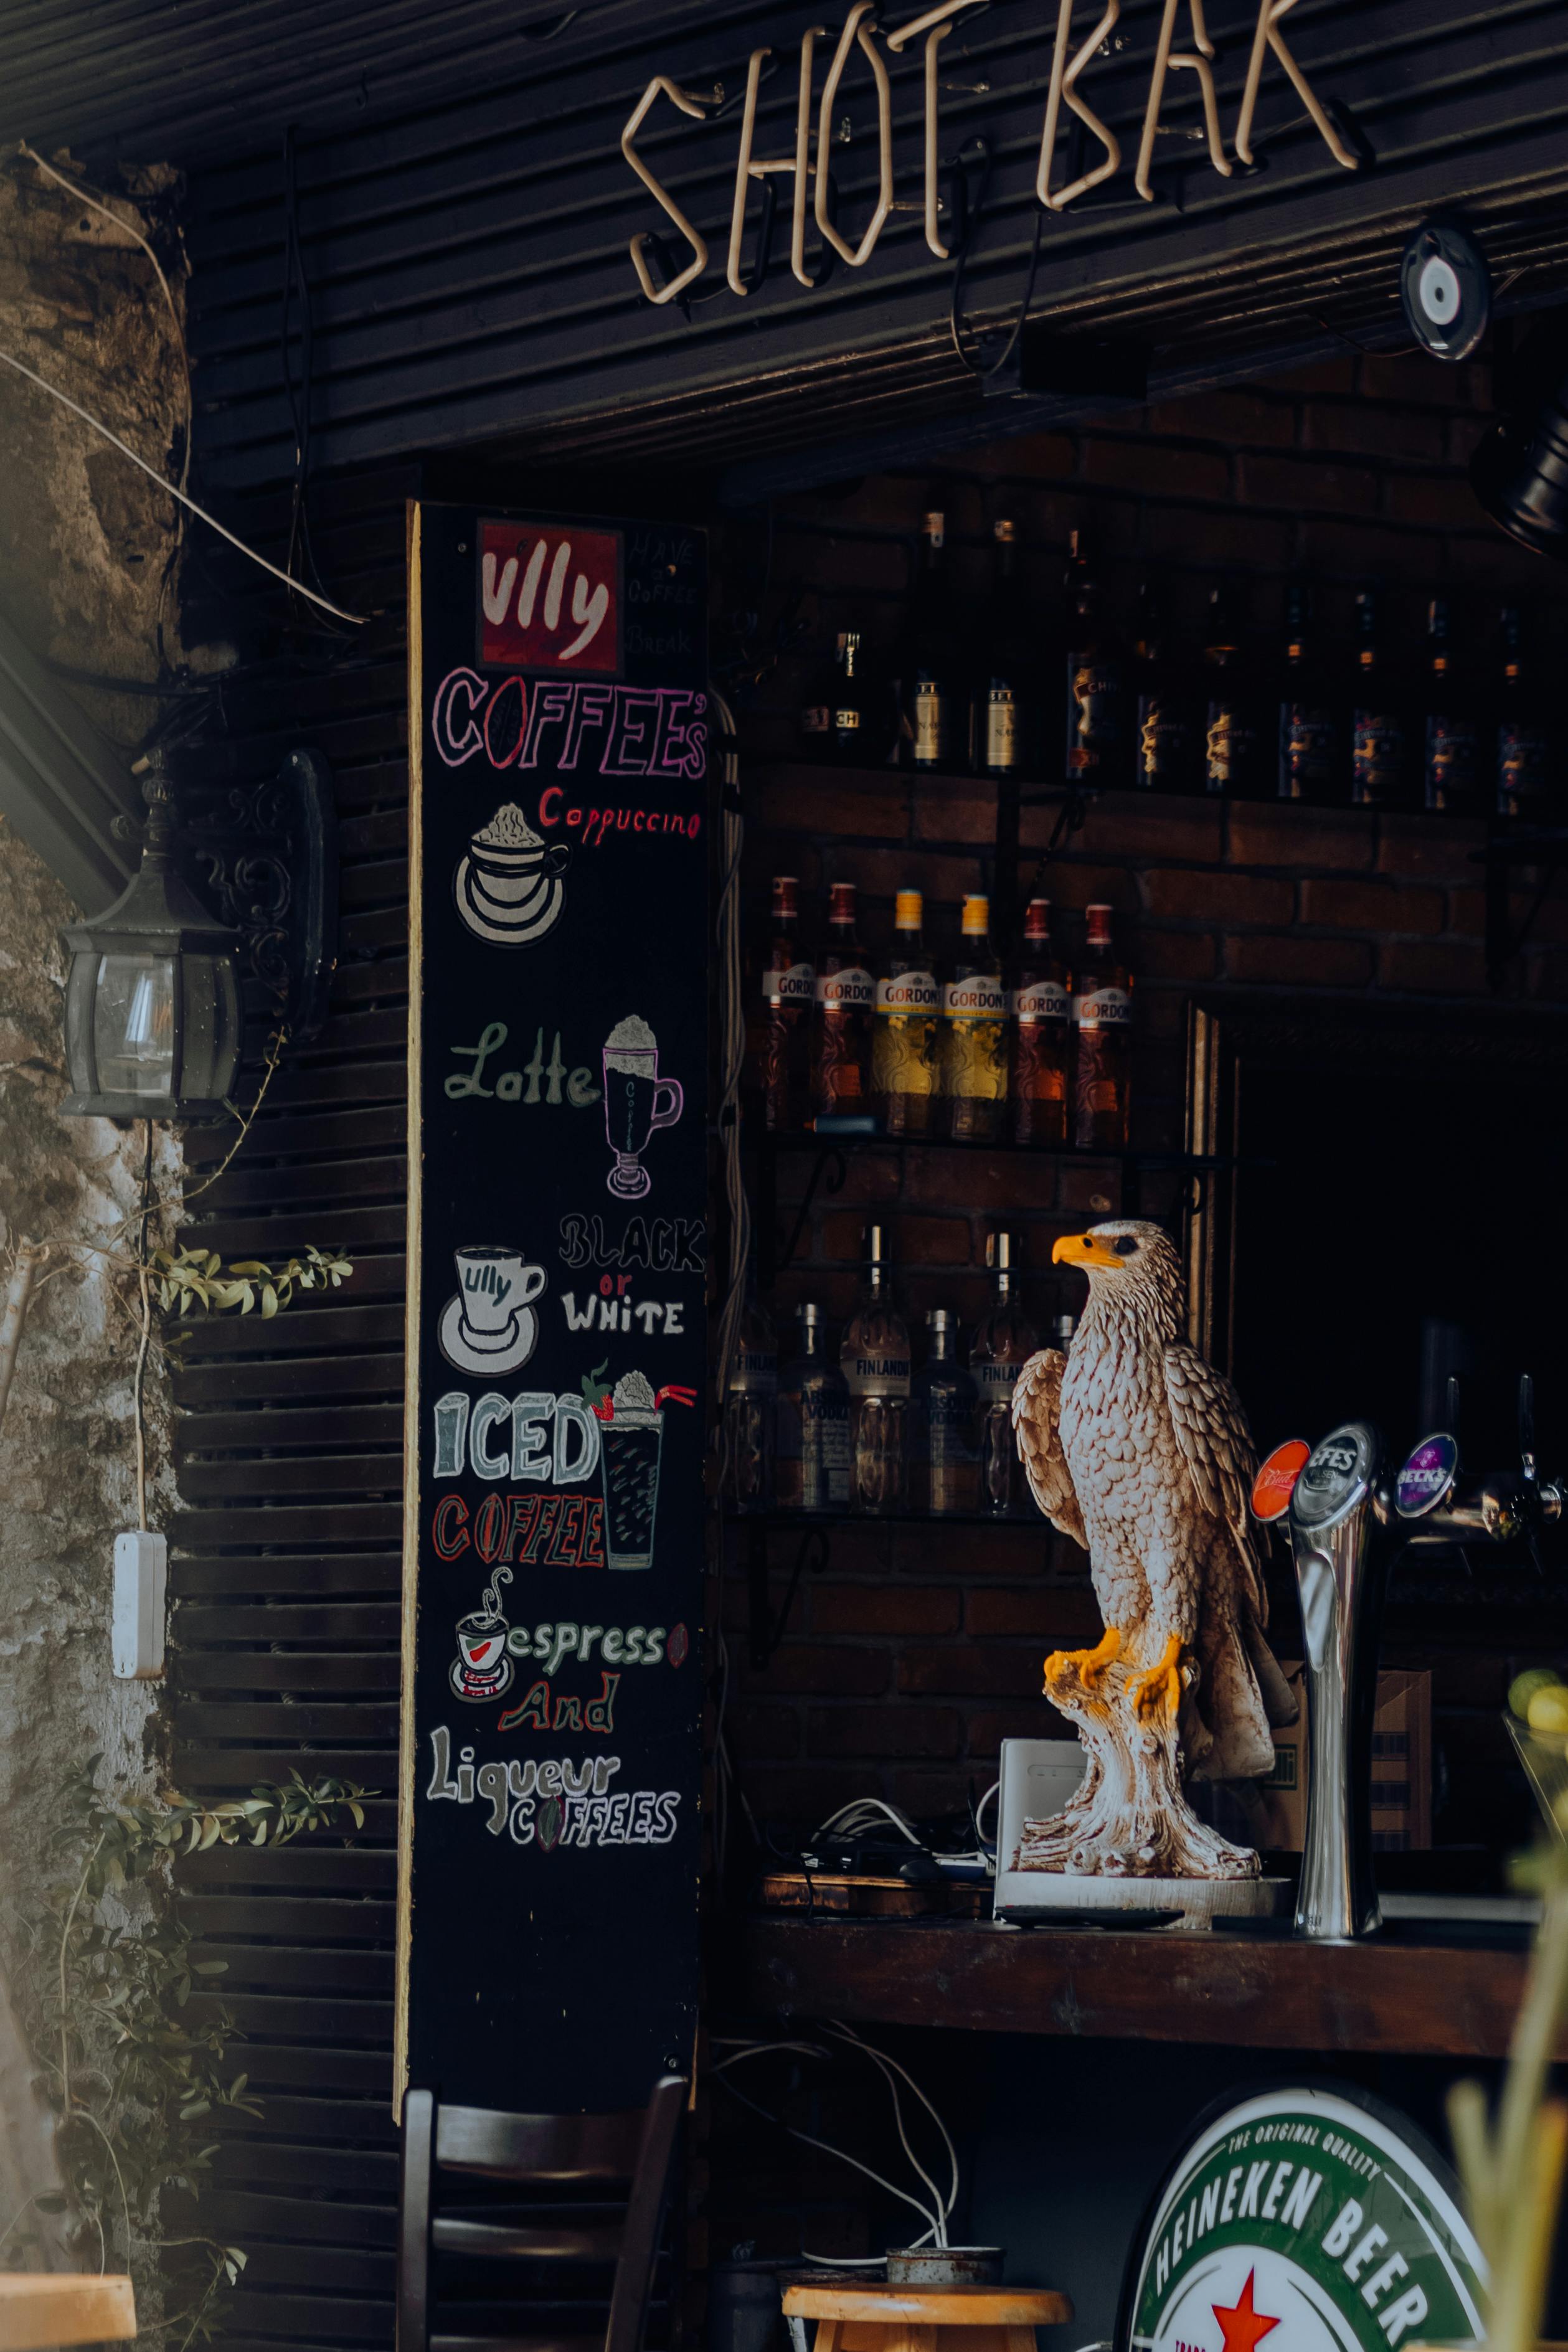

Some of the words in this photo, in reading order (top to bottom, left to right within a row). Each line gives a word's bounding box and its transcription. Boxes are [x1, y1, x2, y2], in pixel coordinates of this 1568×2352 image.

[621, 0, 990, 304] SHOT
[1036, 0, 1360, 211] BAR
[538, 786, 702, 848] Cappuccino
[443, 1021, 602, 1108] Latte
[559, 1214, 706, 1272] BLACK
[433, 1392, 600, 1485] ICED
[1309, 1446, 1358, 1471] EFES
[1399, 1466, 1448, 1483] BECK'S
[433, 1493, 605, 1567] COFFEE
[506, 1622, 689, 1676] espresso
[497, 1670, 622, 1733] And
[427, 1726, 621, 1836] Liqueur
[509, 1791, 682, 1853] COFFEES
[1228, 2129, 1251, 2155] THE
[1255, 2122, 1320, 2147] ORIGINAL
[1322, 2132, 1382, 2182] QUALITY
[1156, 2160, 1323, 2298] HEINEKEN
[1321, 2197, 1429, 2348] BEER
